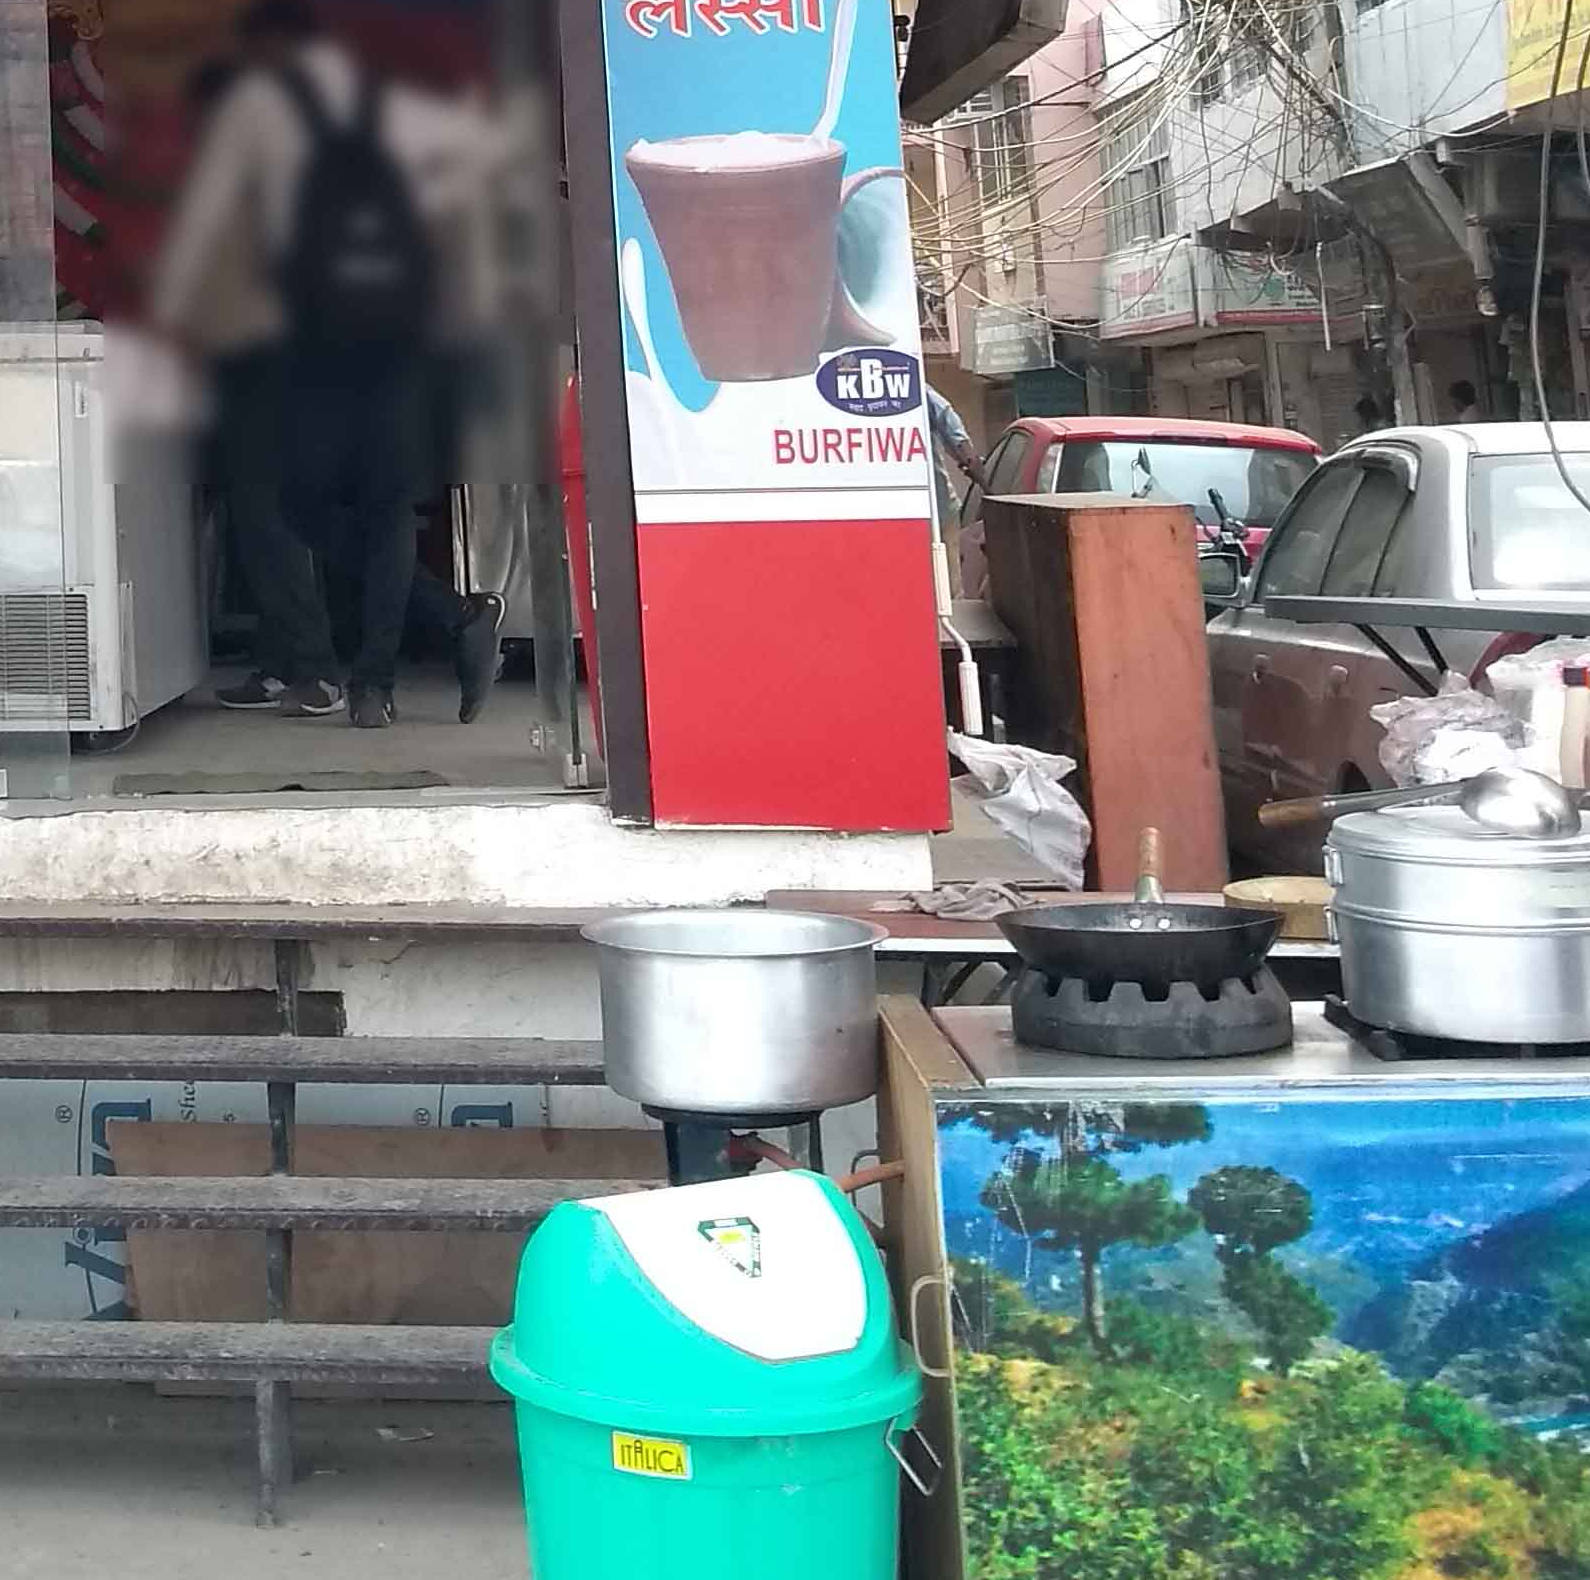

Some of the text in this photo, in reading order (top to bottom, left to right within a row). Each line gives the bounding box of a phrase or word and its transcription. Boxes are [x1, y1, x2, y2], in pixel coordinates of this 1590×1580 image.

[836, 358, 911, 399] KBW
[774, 426, 927, 465] BURFIWA
[620, 1439, 684, 1474] ITALICA
